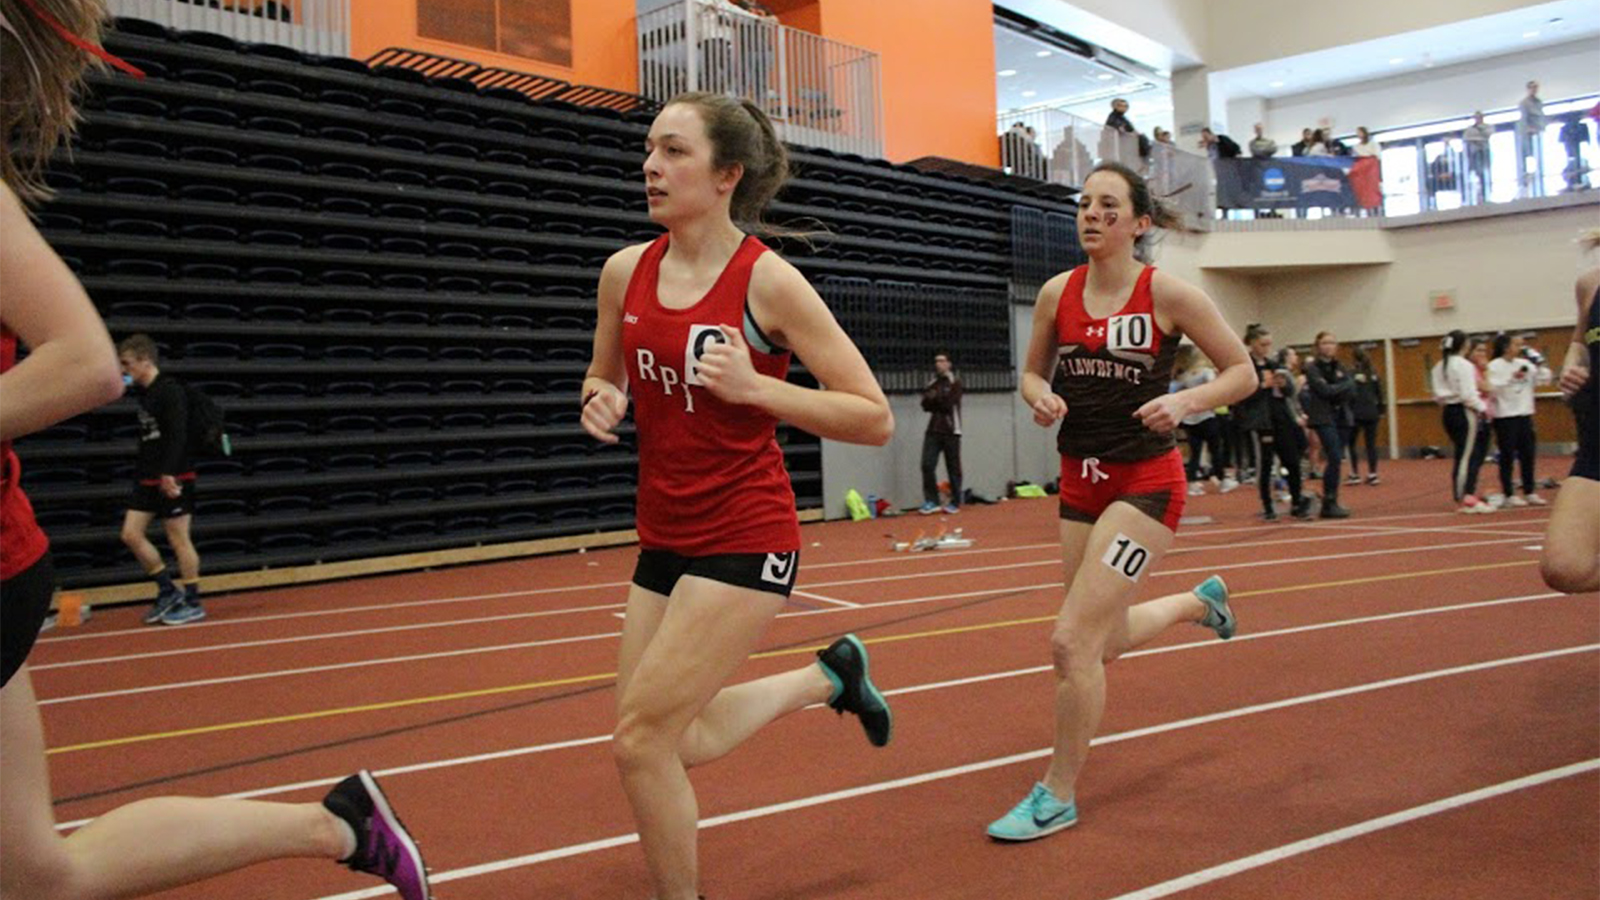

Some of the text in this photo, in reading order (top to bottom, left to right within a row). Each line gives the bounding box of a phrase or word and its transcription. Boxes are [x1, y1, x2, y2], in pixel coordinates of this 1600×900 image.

[1112, 315, 1146, 347] 10
[637, 348, 695, 413] RPI
[1111, 538, 1147, 577] 10
